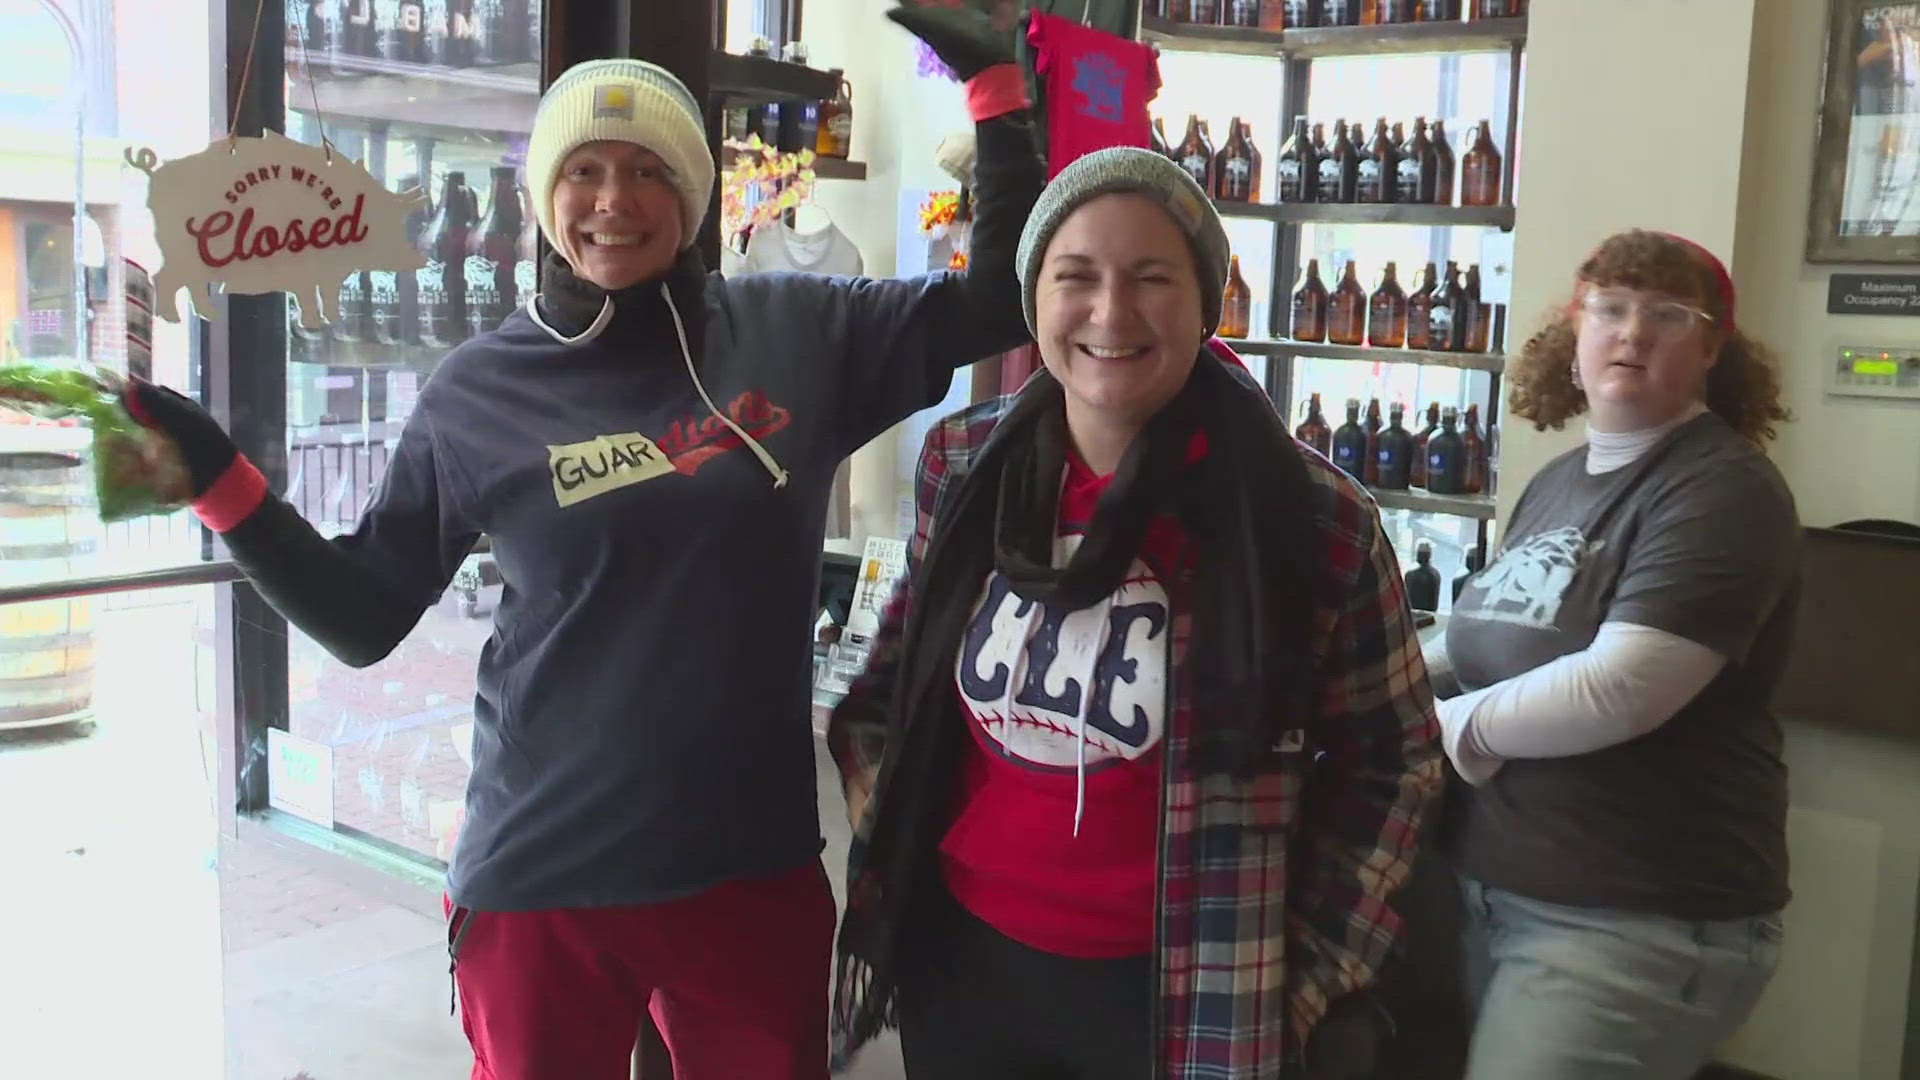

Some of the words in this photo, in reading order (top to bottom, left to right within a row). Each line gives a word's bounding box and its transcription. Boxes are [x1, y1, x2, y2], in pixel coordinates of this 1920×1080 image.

[225, 165, 281, 204] SORRY
[291, 166, 342, 210] WE'RE
[186, 193, 369, 268] Closed
[1843, 293, 1907, 309] Occupancy
[1861, 280, 1917, 293] Maximum
[555, 441, 654, 491] GUAR
[960, 573, 1167, 748] CLE
